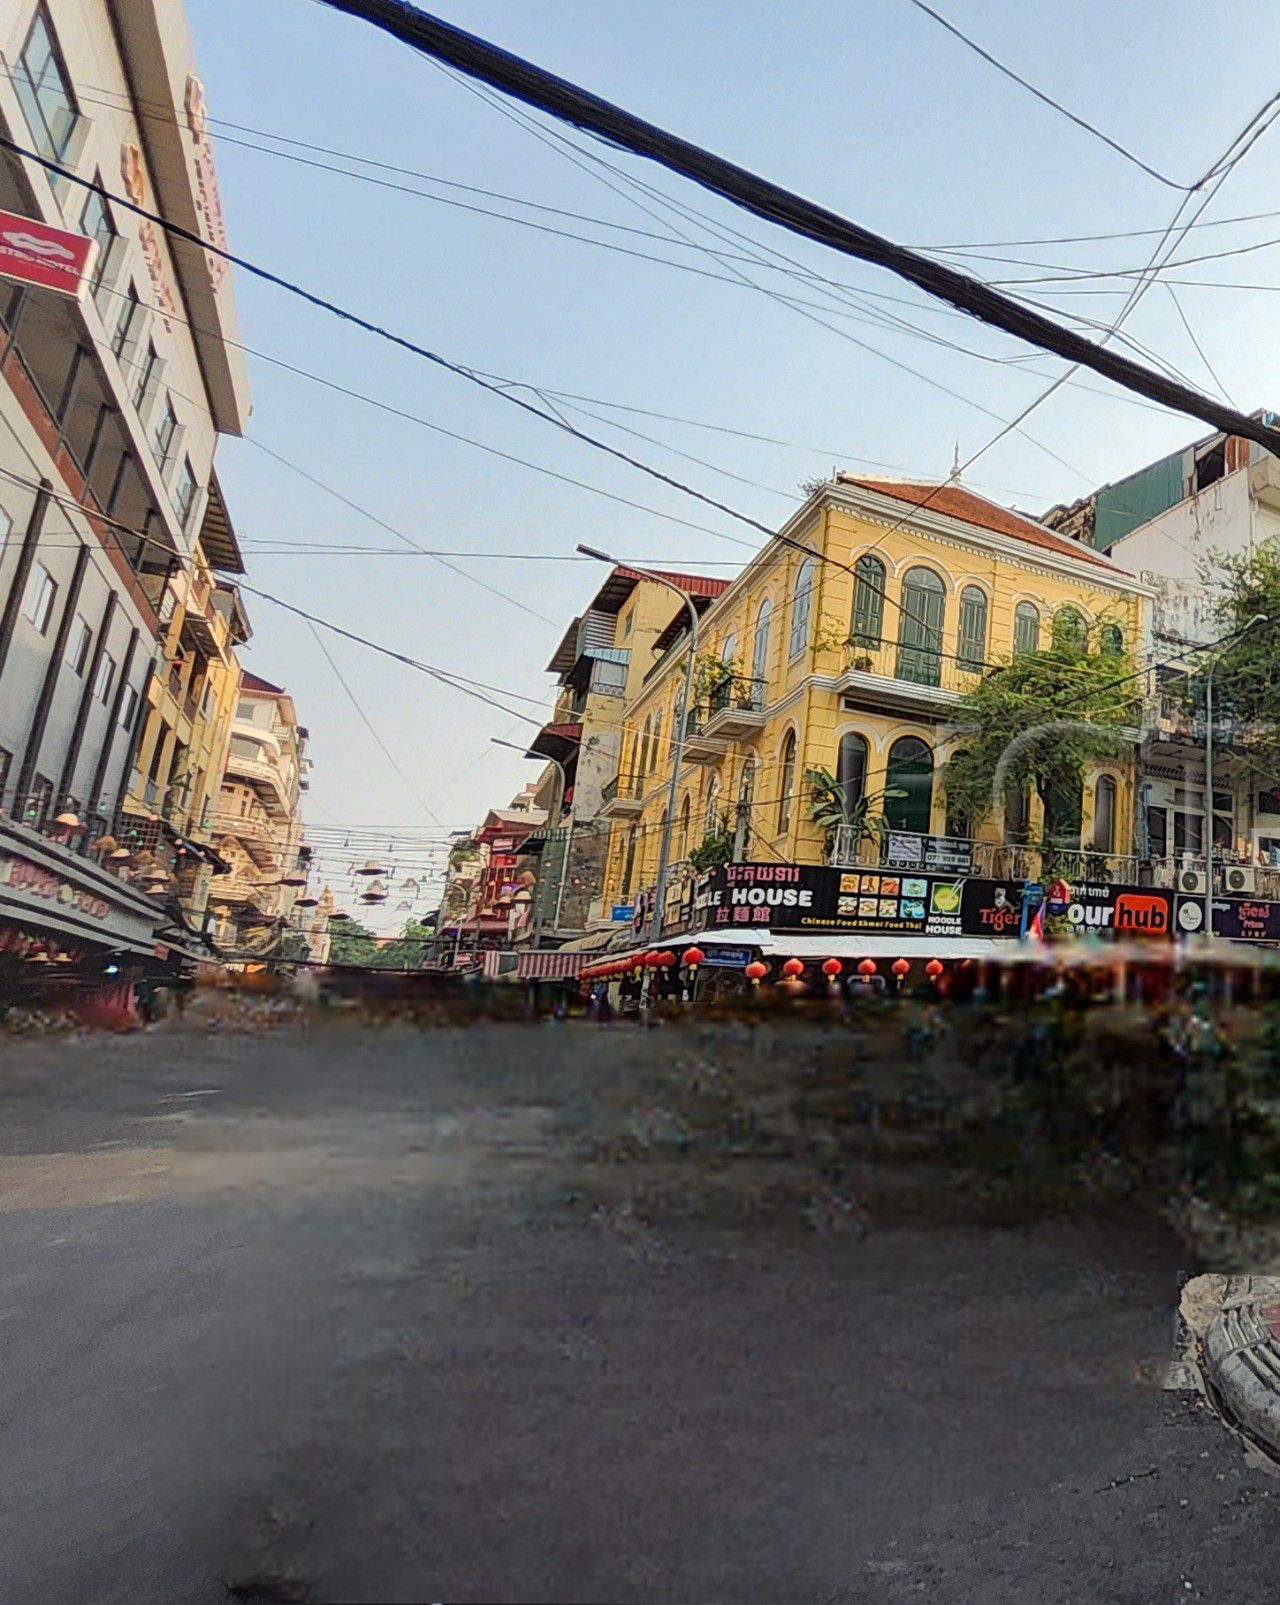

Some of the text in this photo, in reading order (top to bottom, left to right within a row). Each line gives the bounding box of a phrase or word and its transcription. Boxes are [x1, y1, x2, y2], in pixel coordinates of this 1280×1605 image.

[731, 888, 813, 907] HOUSE
[927, 916, 962, 925] NOODLE
[979, 908, 1022, 931] Tiger
[1118, 902, 1165, 928] hub
[800, 917, 836, 926] Chinese
[905, 922, 922, 930] Thai
[925, 925, 962, 935] HOUSE
